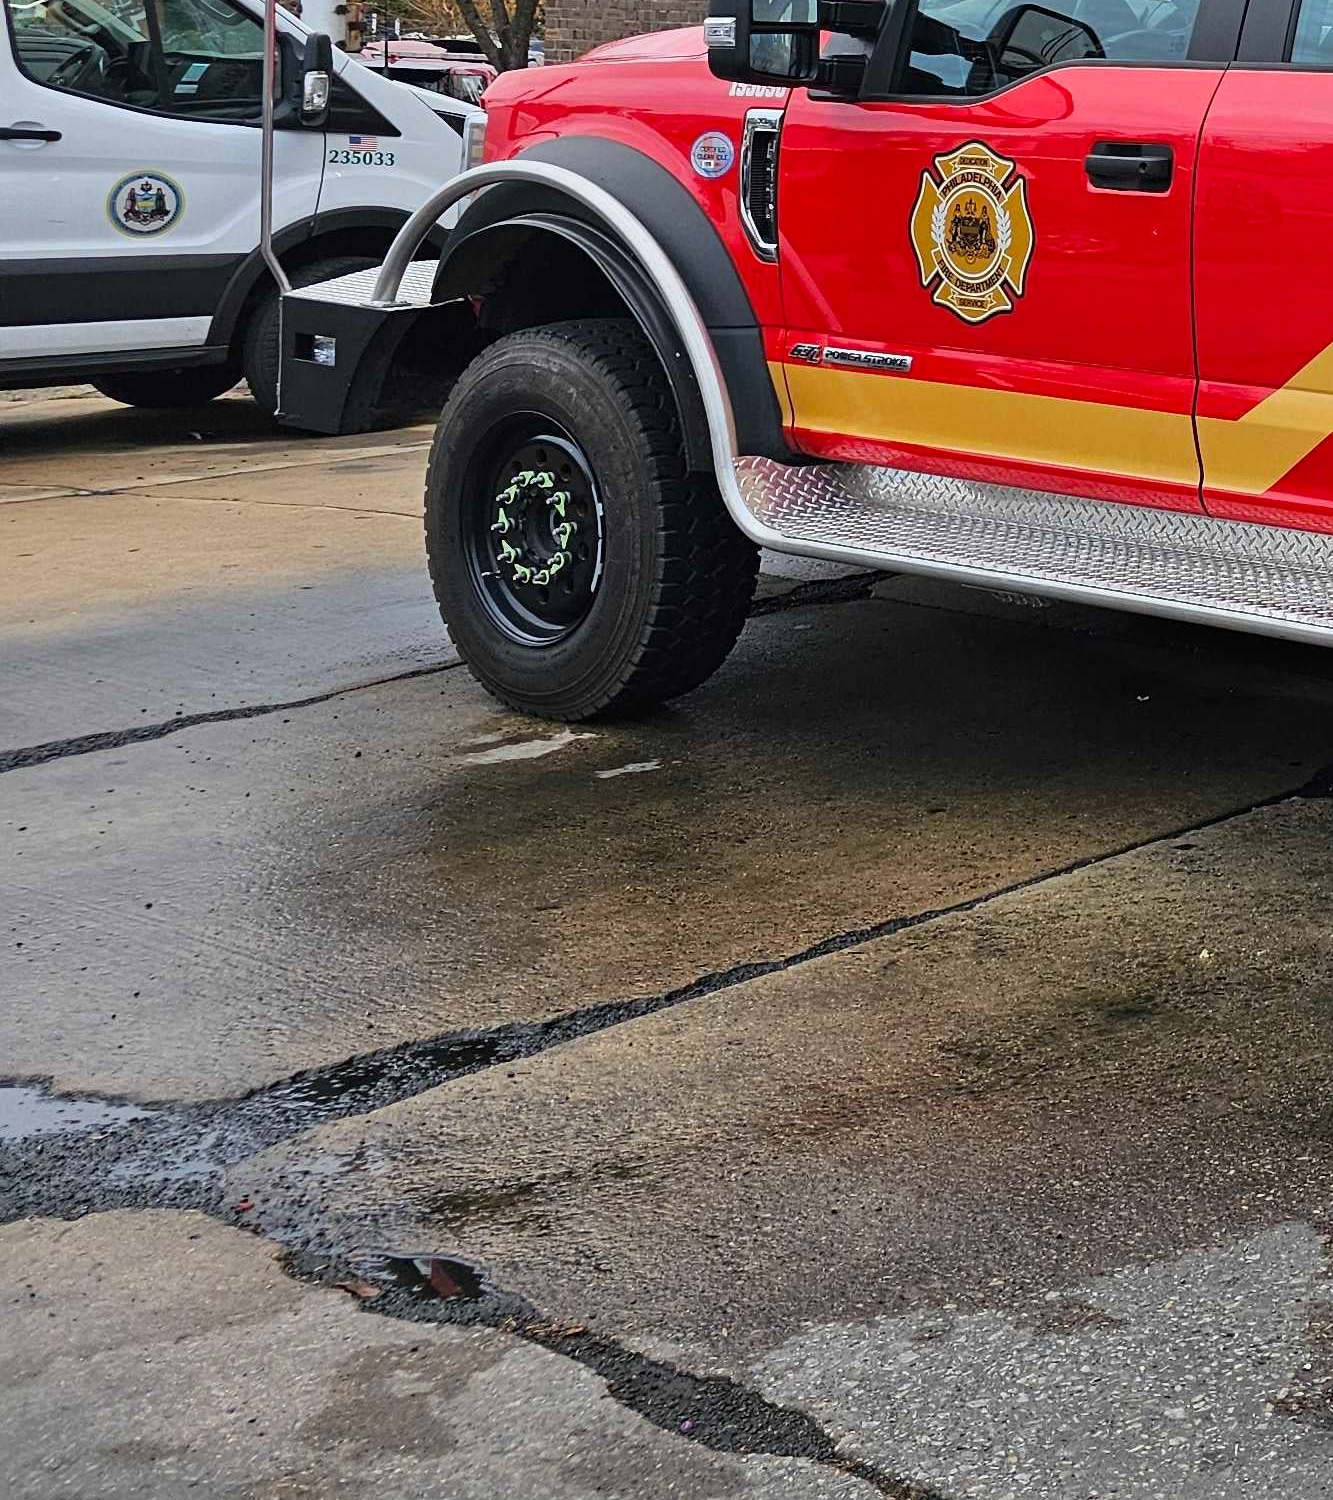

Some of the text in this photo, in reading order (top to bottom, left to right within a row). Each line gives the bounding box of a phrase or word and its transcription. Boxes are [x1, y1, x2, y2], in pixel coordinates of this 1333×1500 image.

[328, 149, 395, 167] 235033
[940, 172, 1002, 200] PHILADELPHIA
[937, 258, 1006, 294] FIRE DEPARTMENT
